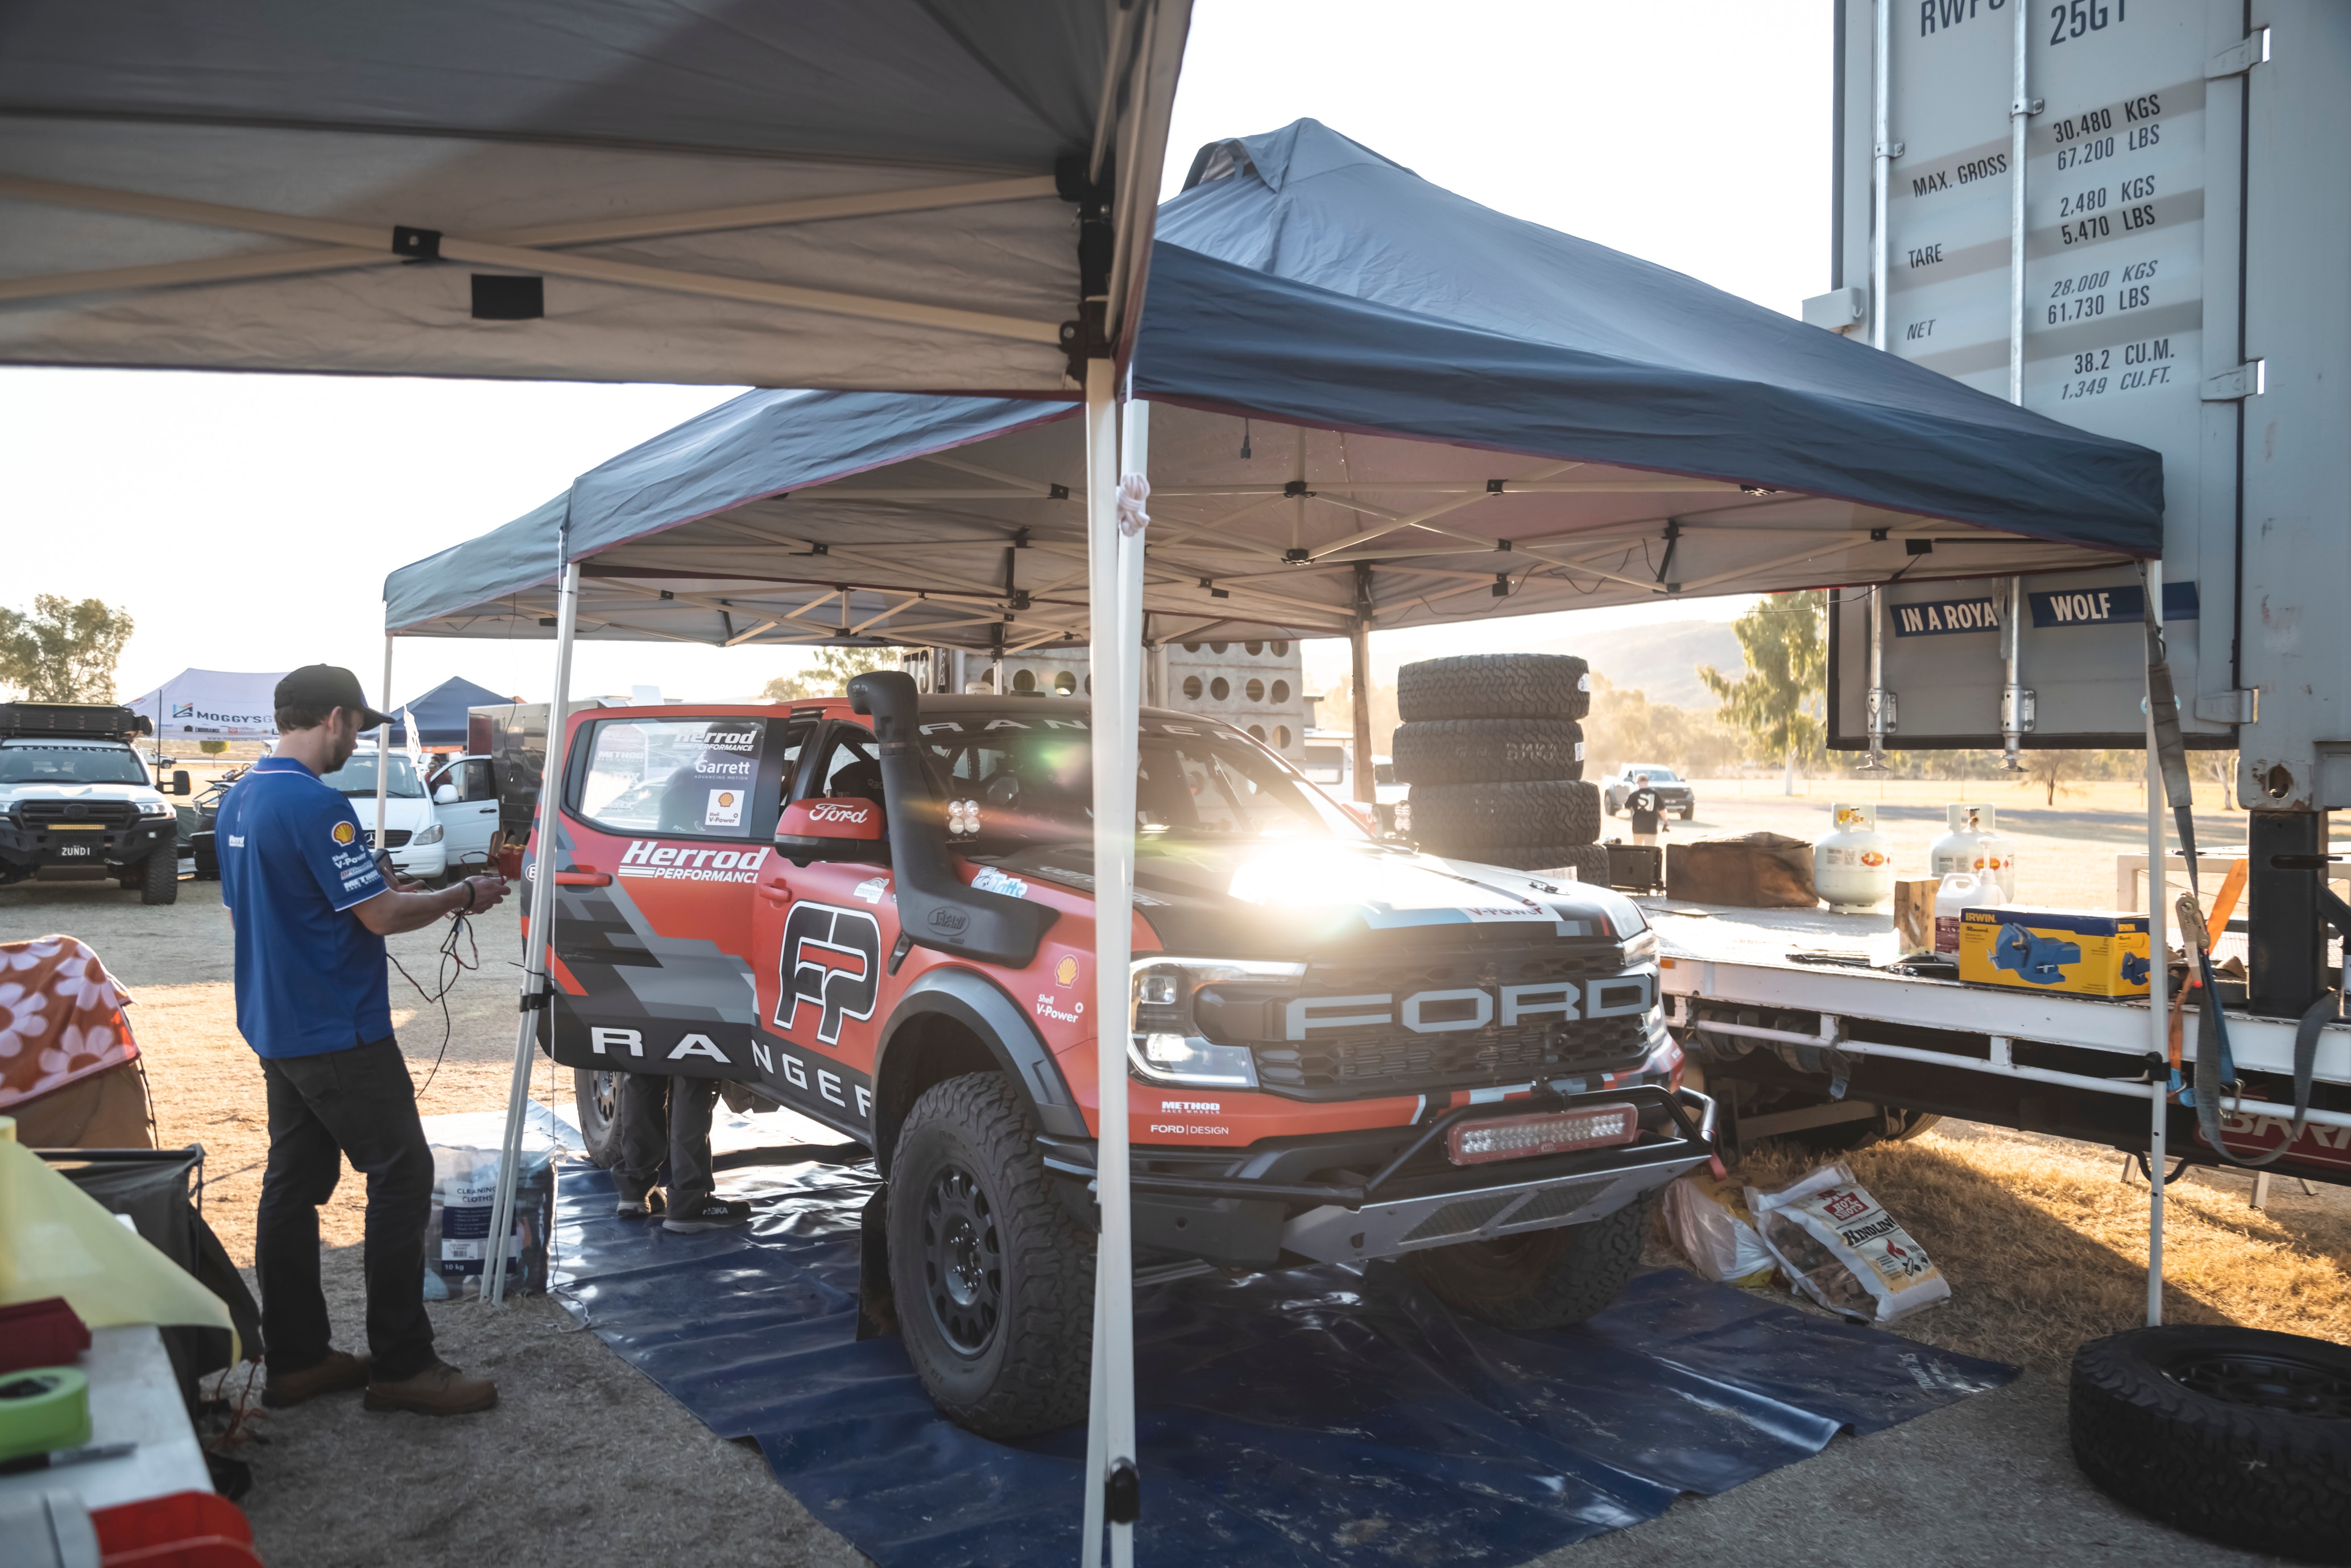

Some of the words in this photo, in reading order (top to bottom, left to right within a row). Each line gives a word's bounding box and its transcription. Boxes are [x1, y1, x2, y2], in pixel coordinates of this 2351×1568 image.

[2054, 109, 2112, 143] 30,480
[2125, 94, 2161, 122] KGS
[2057, 138, 2114, 171] 67,200
[2128, 125, 2160, 151] LBS
[1913, 172, 1953, 197] MAX.
[1957, 155, 2007, 185] GROSS
[2060, 188, 2106, 218] 2,480
[2121, 176, 2155, 202] KGS
[2062, 216, 2110, 245] 5,470
[2123, 205, 2155, 231] LBS
[1908, 245, 1943, 269] TARE
[2051, 271, 2109, 299] 28,000
[2122, 260, 2158, 283] KGS
[2048, 295, 2105, 325] 61,730
[2119, 286, 2150, 311] LBS
[1907, 319, 1936, 340] NET
[2074, 350, 2110, 375] 38.2
[2125, 340, 2175, 366] CU.M.
[2062, 377, 2108, 401] 1,349
[2120, 367, 2171, 391] CU.FT.
[1901, 608, 1923, 632] IN
[1928, 606, 1942, 631] A
[1946, 602, 1998, 629] ROYA
[2050, 593, 2111, 622] WOLF
[672, 731, 757, 744] Herrod
[919, 719, 1251, 744] RANER
[696, 760, 750, 774] Garrett
[809, 803, 868, 824] Ford
[332, 852, 349, 862] Shell
[620, 841, 771, 870] Herrod
[929, 910, 966, 930] SAFARI
[1965, 912, 1996, 923] IRWIN
[1038, 994, 1054, 1004] Shell
[1286, 974, 1652, 1041] FORD
[1037, 1003, 1078, 1023] V-Power
[1162, 1101, 1220, 1110] METHOD
[1150, 1124, 1185, 1133] FORD
[1190, 1126, 1229, 1135] DESIGN
[1832, 1197, 1855, 1212] HOT
[1835, 1200, 1864, 1219] SHOTS
